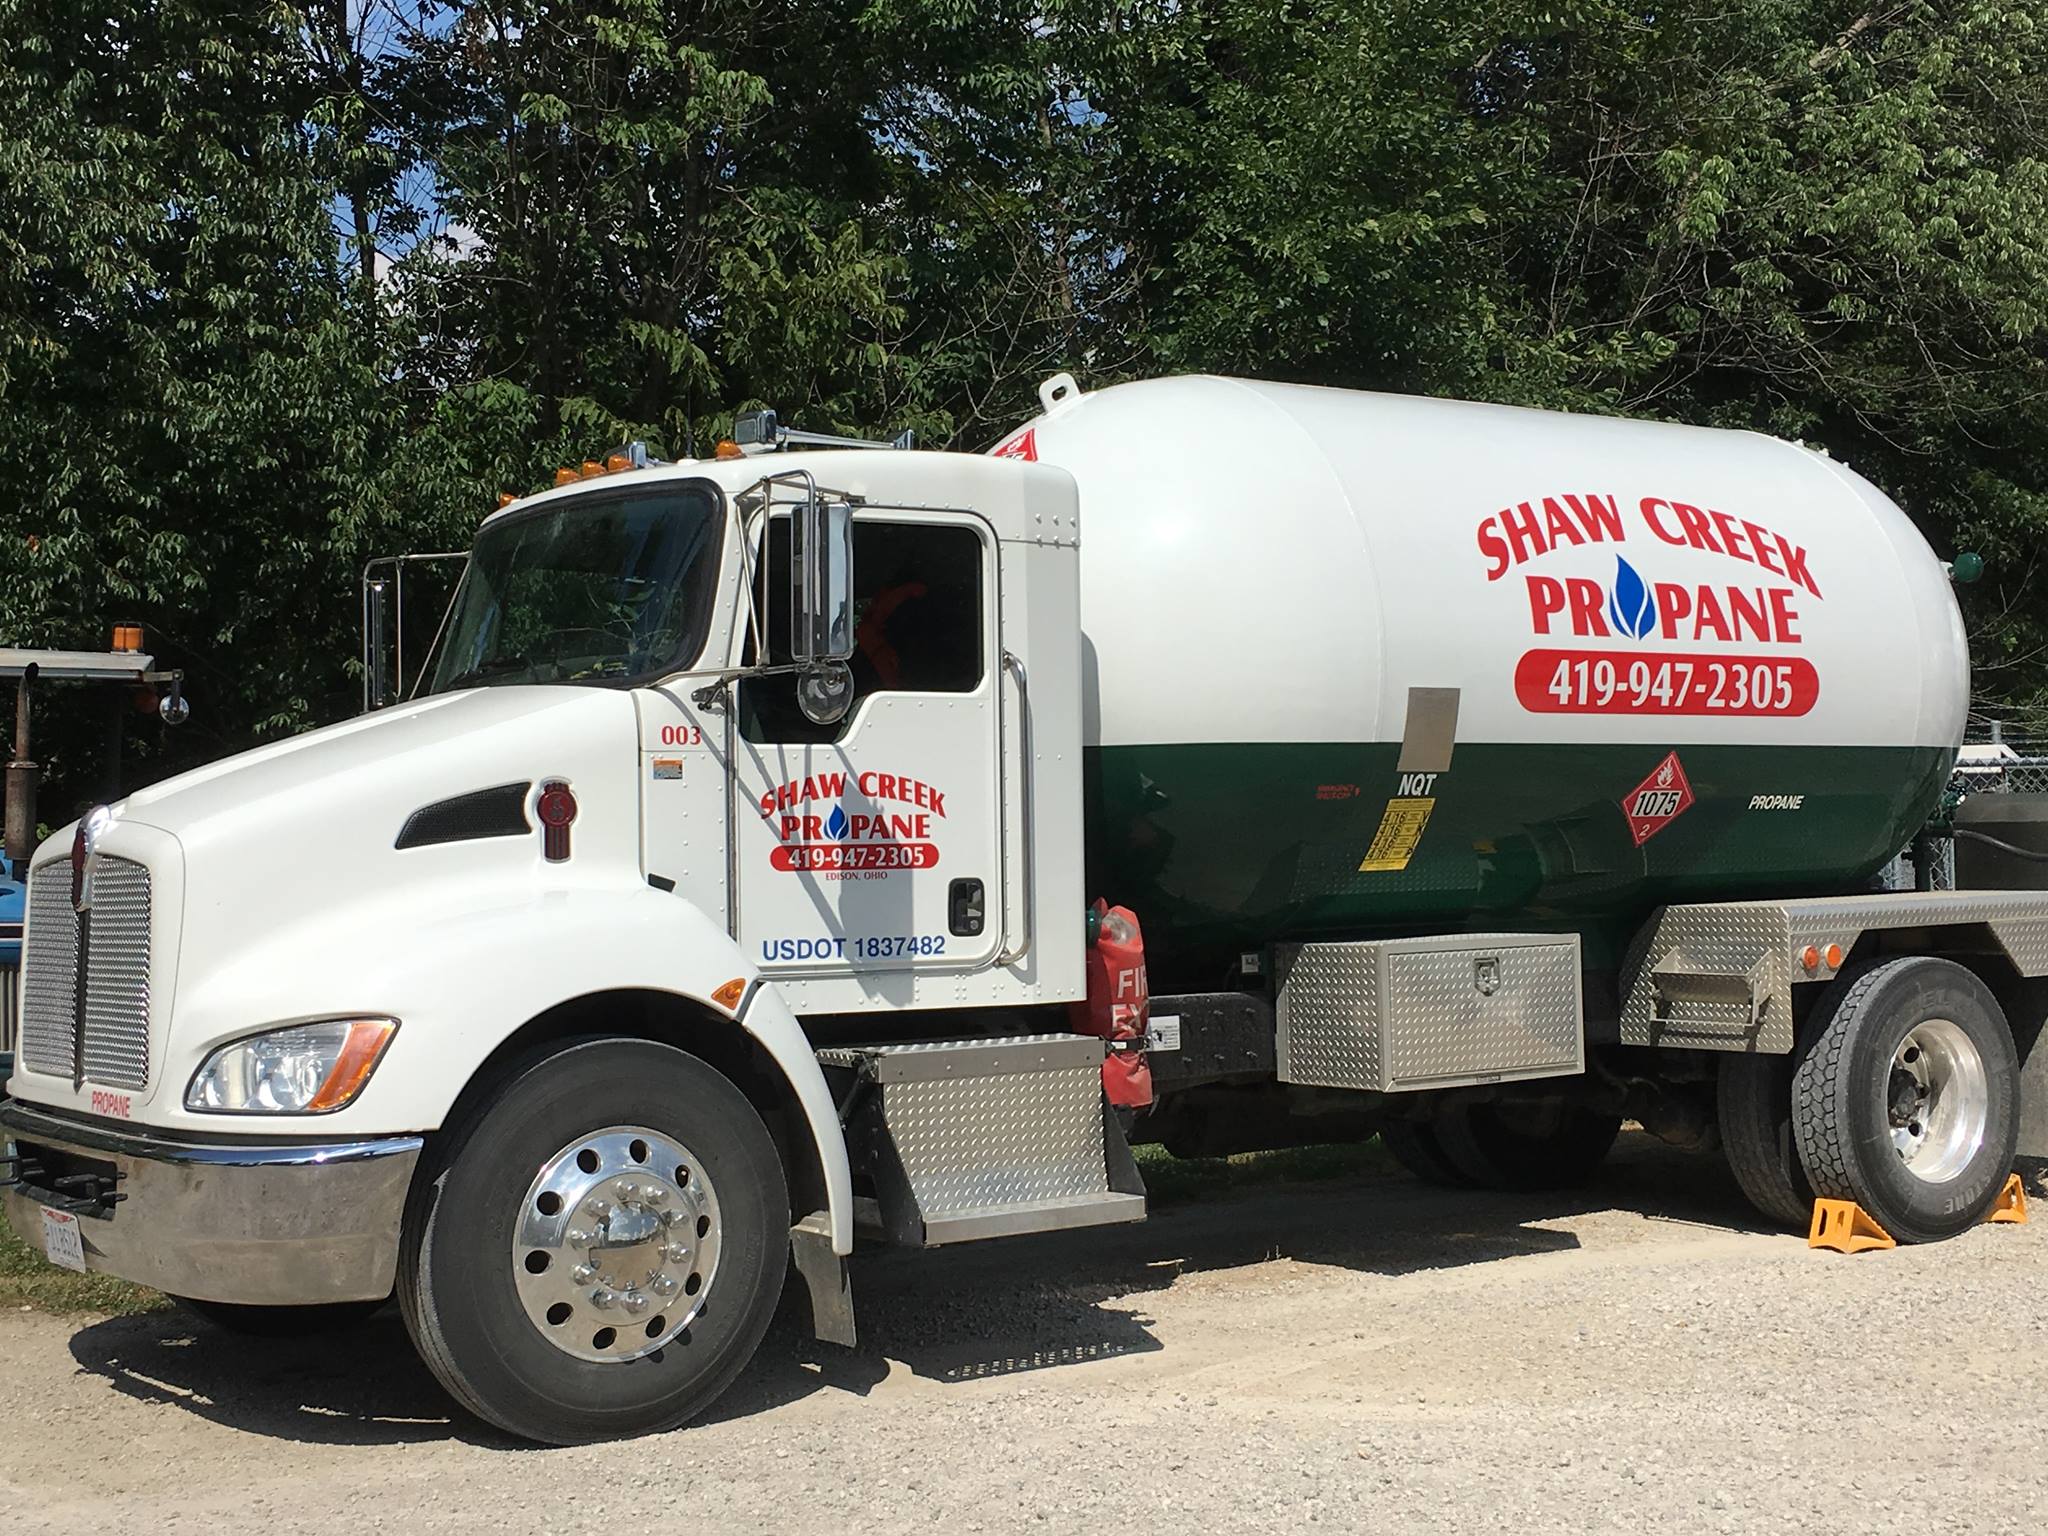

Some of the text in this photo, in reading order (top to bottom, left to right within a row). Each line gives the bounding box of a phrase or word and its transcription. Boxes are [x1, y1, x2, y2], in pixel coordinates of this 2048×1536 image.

[1476, 494, 1824, 601] SHAW CREEK
[1548, 659, 1793, 709] 419-947-2305
[661, 725, 701, 745] 003
[760, 771, 947, 819] SHAW CREEK
[1397, 774, 1437, 796] NQT
[1634, 792, 1680, 815] 1075
[1748, 795, 1804, 810] PROPANE
[1639, 824, 1649, 837] 2
[788, 846, 925, 867] 419-947-2305
[825, 870, 887, 881] EDISON, OHIO
[763, 936, 945, 960] USDOT 1837482
[92, 1091, 130, 1118] PROPANE
